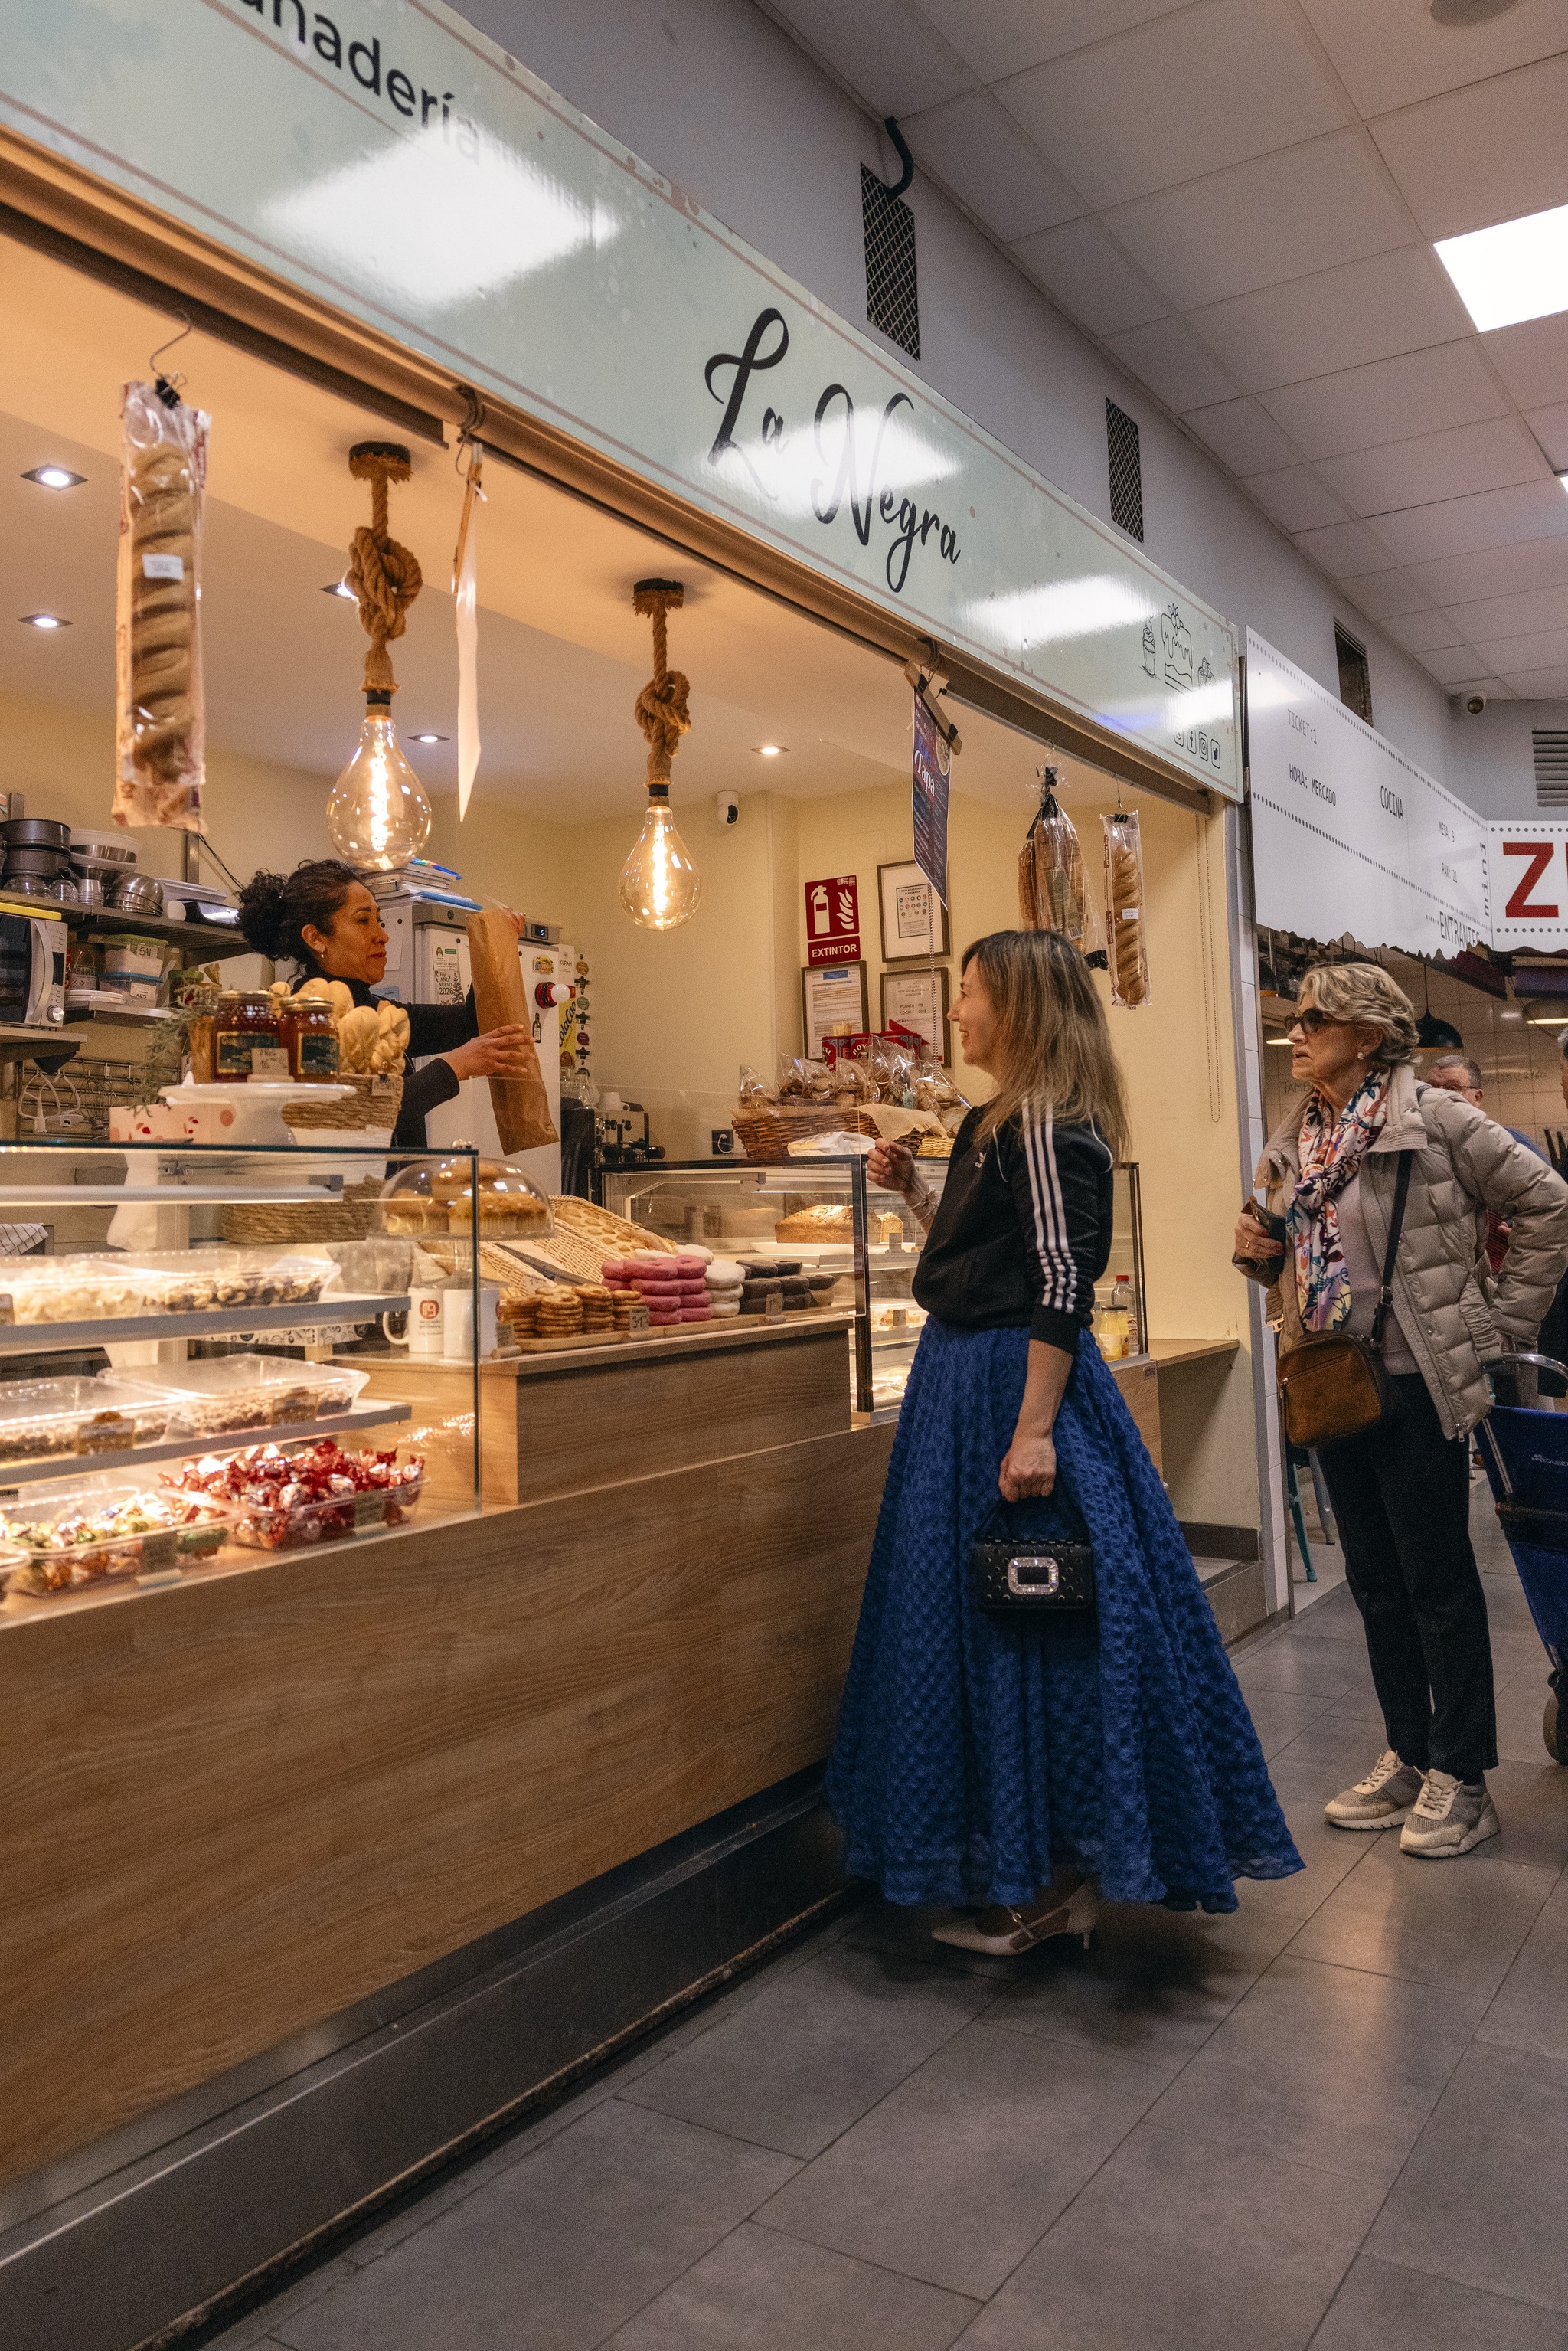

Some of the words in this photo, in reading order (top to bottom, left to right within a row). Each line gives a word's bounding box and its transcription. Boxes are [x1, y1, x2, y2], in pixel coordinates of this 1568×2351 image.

[704, 308, 789, 501] La
[810, 383, 962, 593] Negra
[1289, 763, 1308, 790] HORA:
[1311, 777, 1337, 807] MERCADO
[1380, 785, 1404, 822] COCINA
[1502, 842, 1568, 918] Z
[139, 947, 153, 957] SAL
[812, 943, 858, 958] EXTINTOR
[439, 986, 454, 996] 2026
[852, 1043, 867, 1056] ROY
